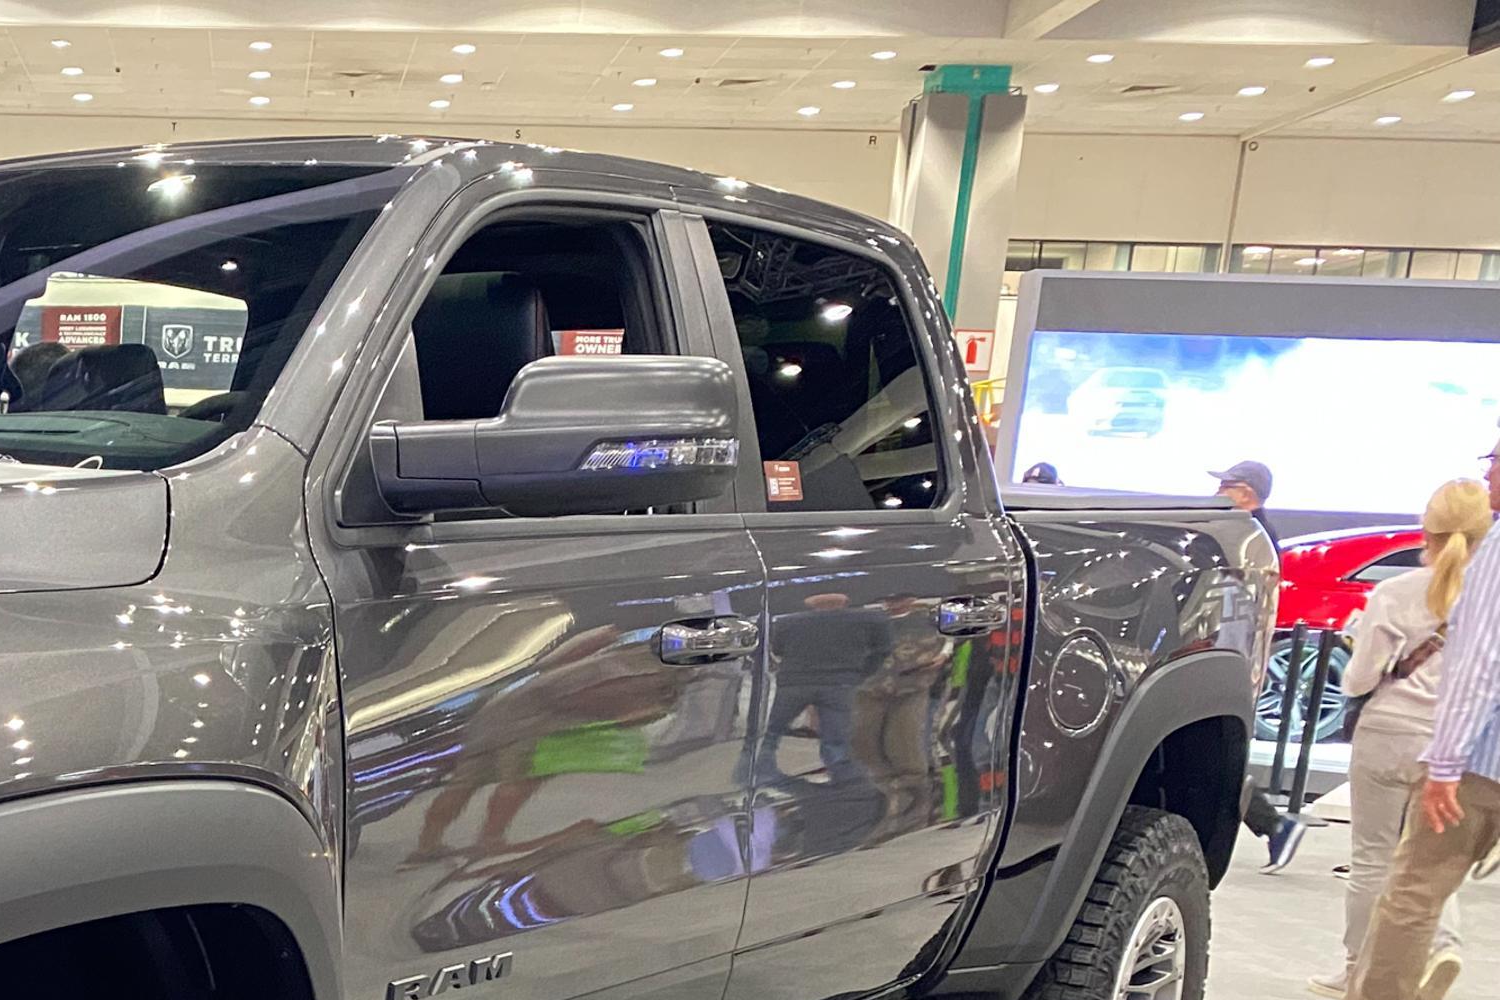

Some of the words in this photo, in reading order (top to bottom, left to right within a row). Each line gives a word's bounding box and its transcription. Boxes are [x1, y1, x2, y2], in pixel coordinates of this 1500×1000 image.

[172, 122, 178, 132] T
[516, 128, 522, 140] S
[868, 134, 878, 146] R
[59, 313, 82, 322] RAM
[83, 312, 107, 322] 1500
[58, 335, 107, 344] ADVANCED
[576, 336, 600, 344] MORE
